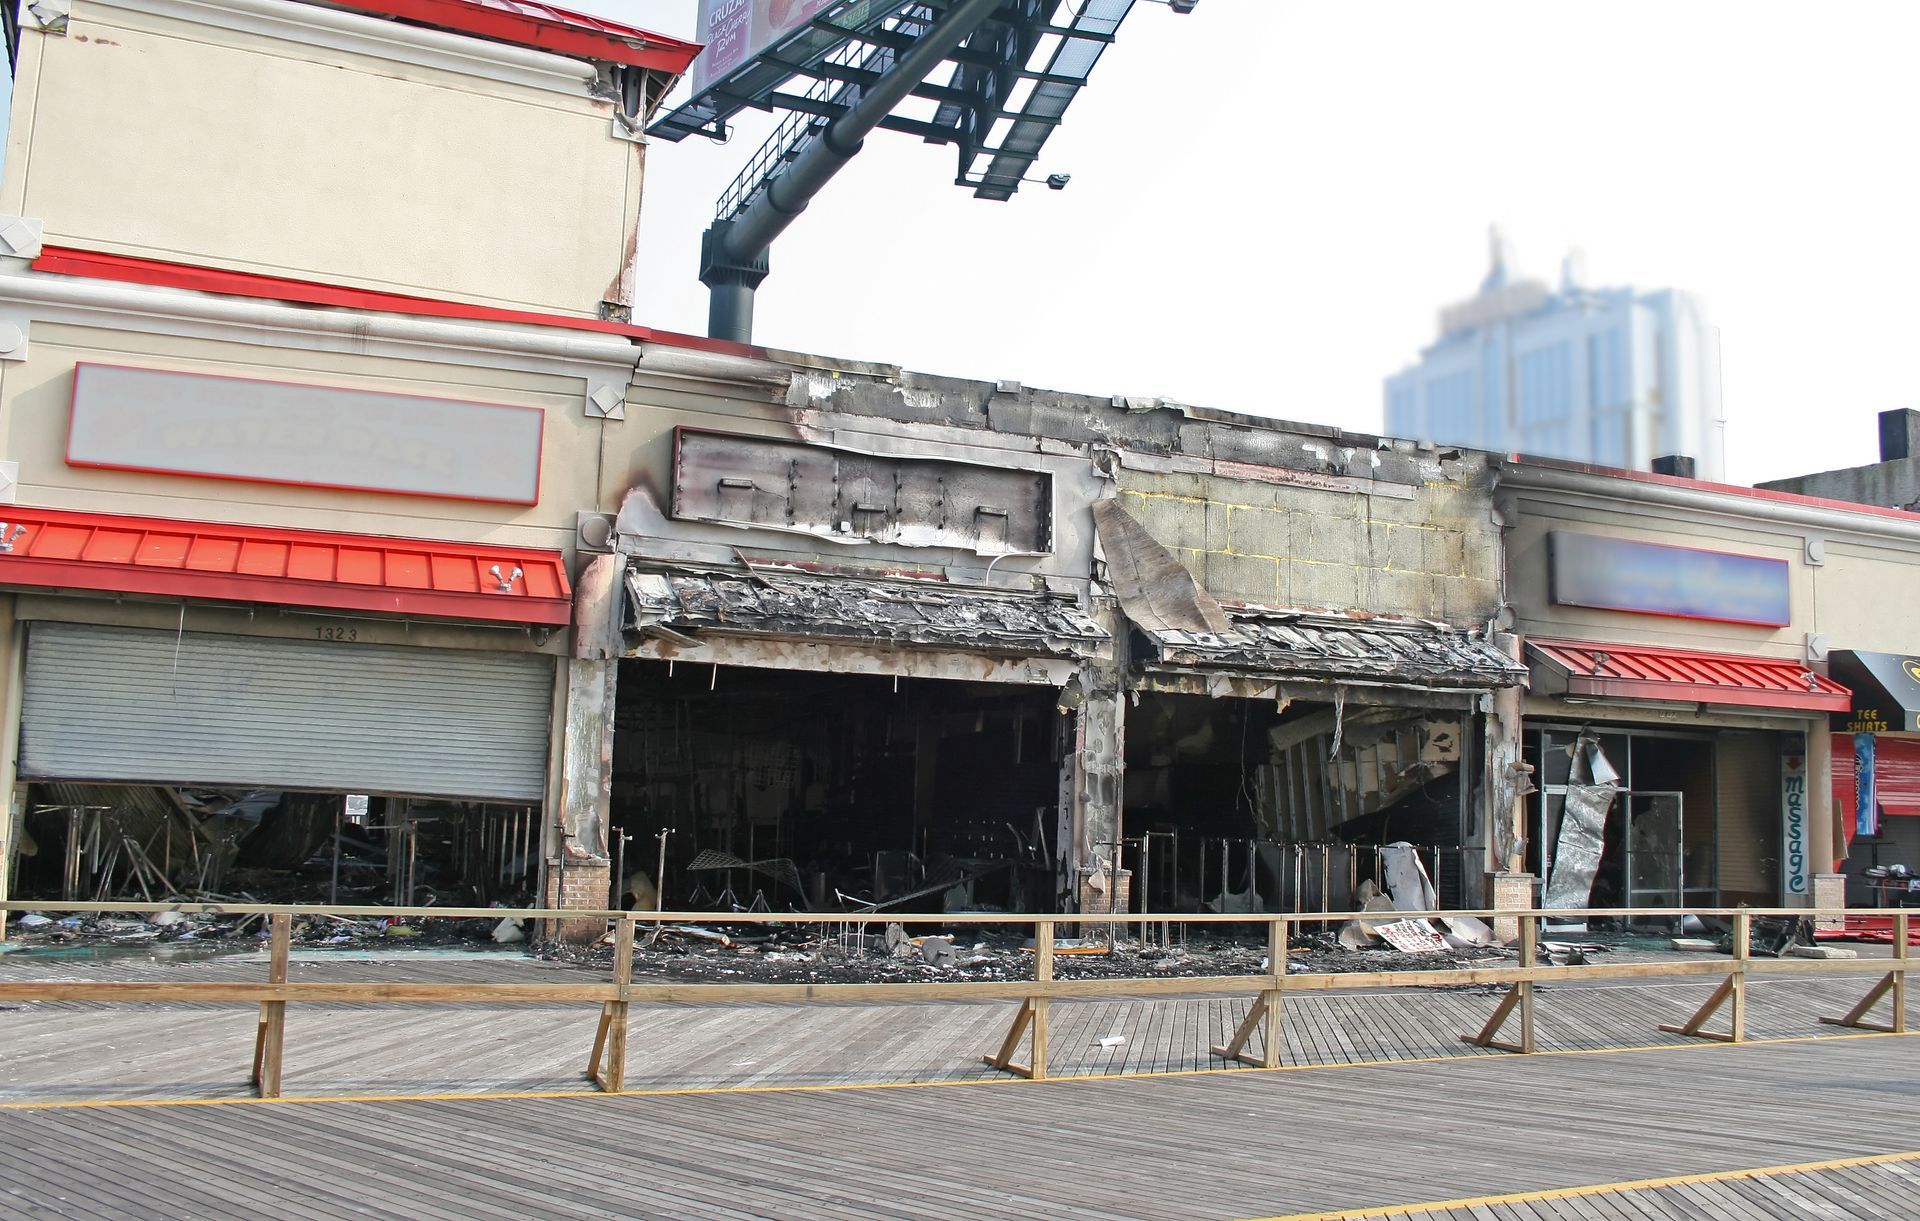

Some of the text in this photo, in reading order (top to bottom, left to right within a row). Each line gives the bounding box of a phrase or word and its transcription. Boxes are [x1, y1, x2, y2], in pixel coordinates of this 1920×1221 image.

[315, 626, 358, 641] 1323
[1857, 709, 1878, 720] TEE
[1846, 721, 1889, 732] SHIRTS
